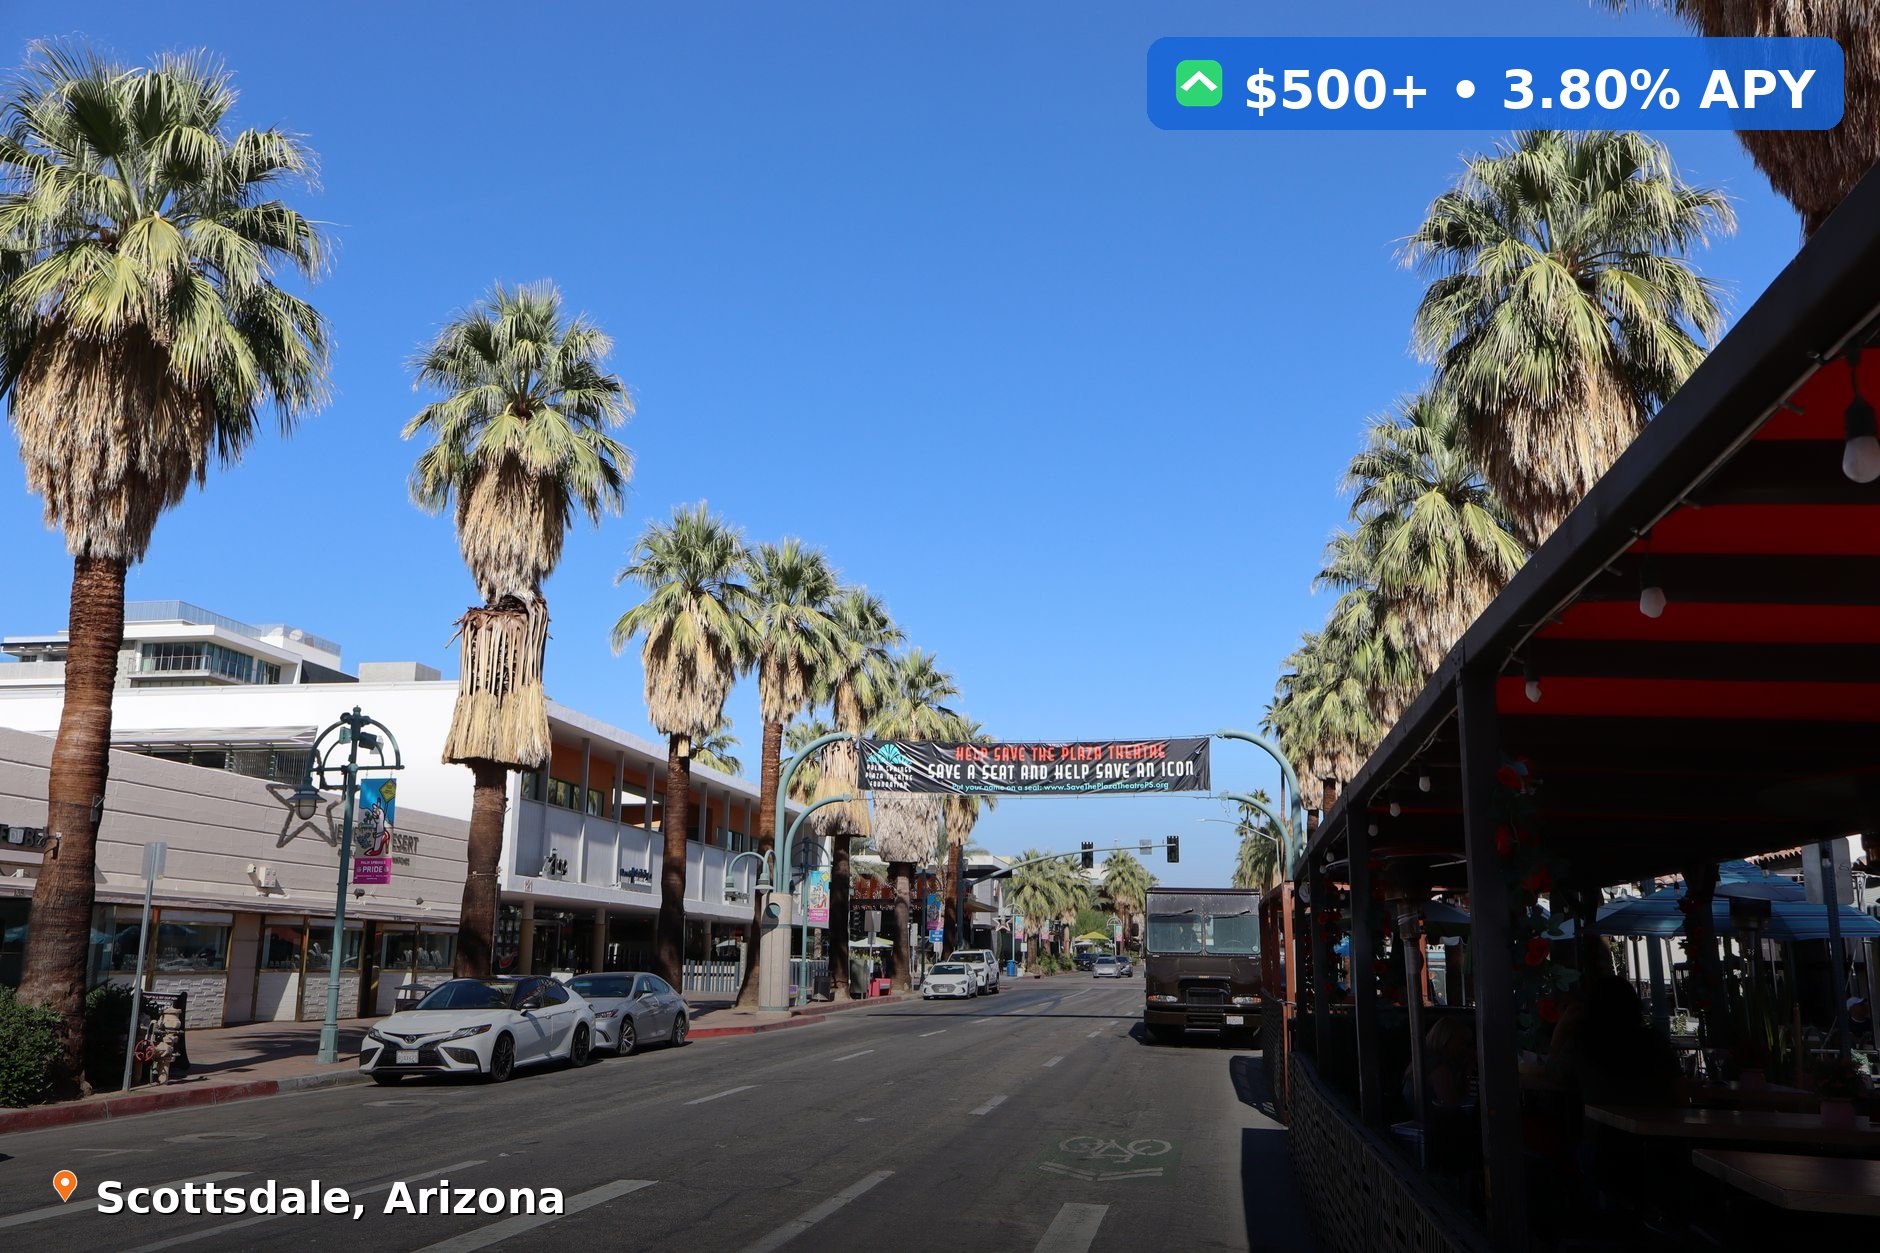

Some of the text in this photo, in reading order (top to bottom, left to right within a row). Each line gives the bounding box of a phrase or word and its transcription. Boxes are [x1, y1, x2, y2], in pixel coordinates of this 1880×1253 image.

[955, 743, 1166, 761] HELP SAVE THE PLAZA THEATRE
[928, 760, 1194, 780] SAVE A SEAT AND HELP SAVE AN ICON
[1043, 781, 1169, 791] www.SaveThePlazaTheatrePS.org
[362, 865, 384, 873] PRIDE
